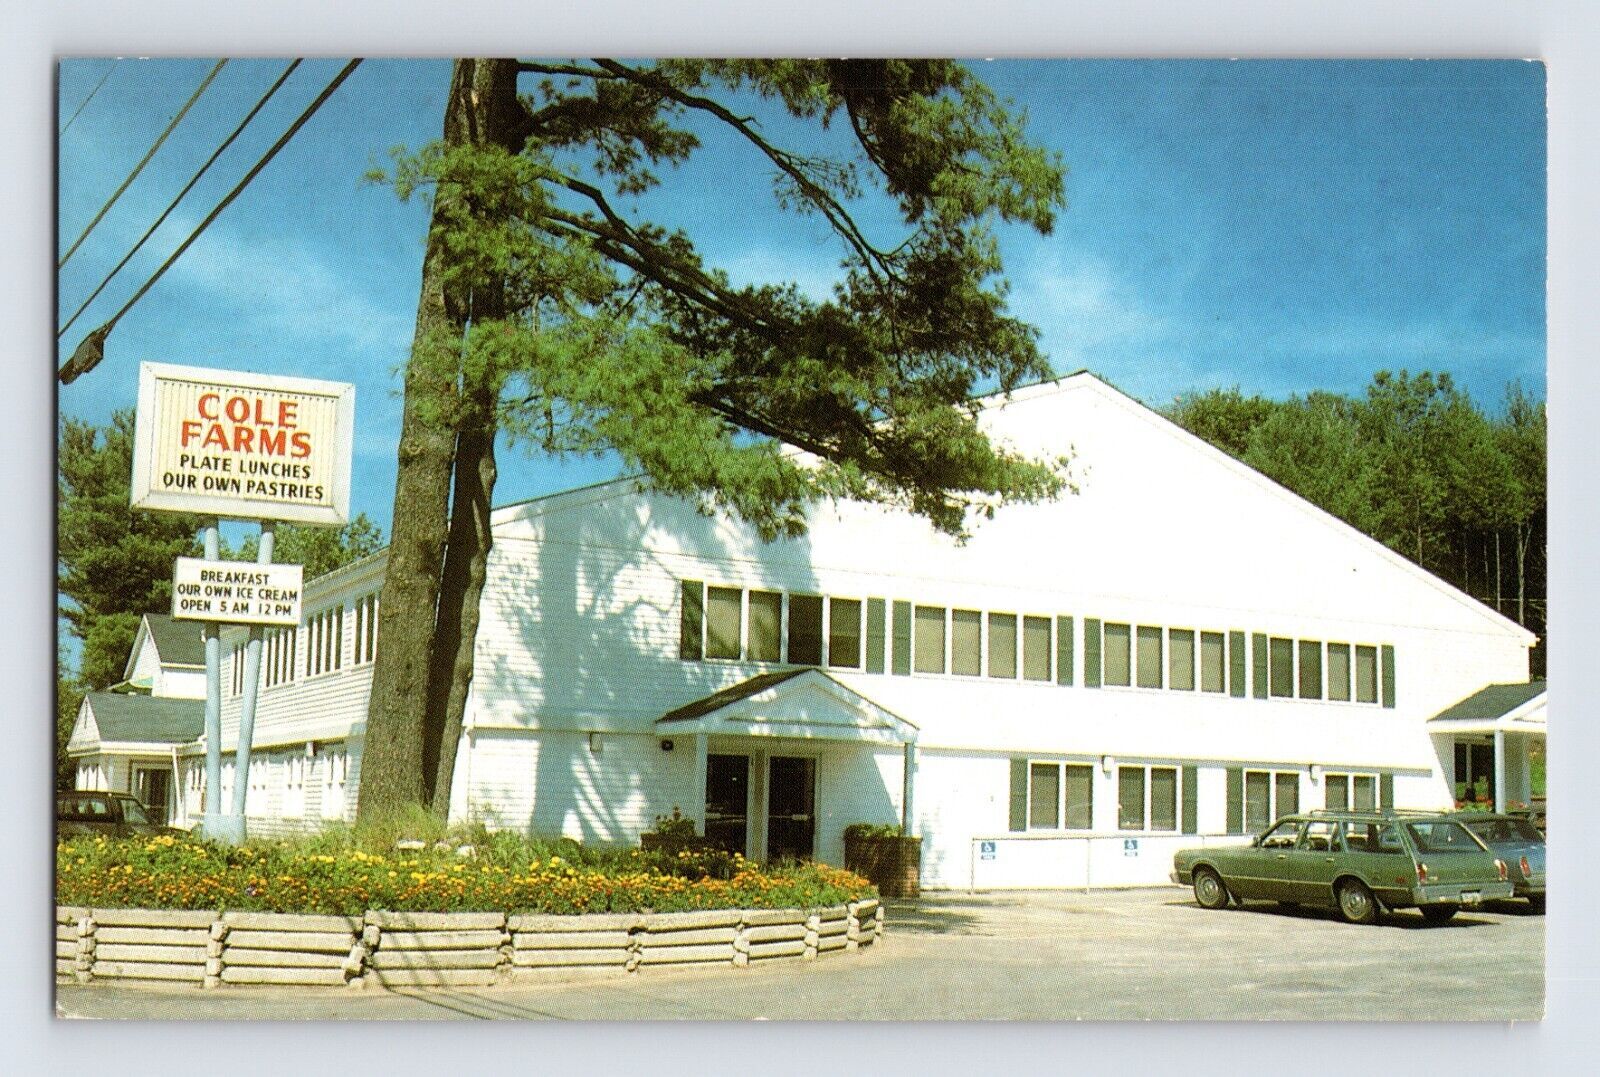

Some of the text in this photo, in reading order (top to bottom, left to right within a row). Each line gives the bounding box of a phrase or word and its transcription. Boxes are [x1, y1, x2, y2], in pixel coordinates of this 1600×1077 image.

[198, 393, 298, 429] COLE
[181, 421, 312, 459] FARMS
[180, 454, 311, 479] PLATE LUNCHES
[163, 472, 324, 500] OUR OWN PASTRIES
[201, 570, 270, 585] BREAKFAST
[178, 584, 298, 601] OUR OWN ICE CREAM
[181, 600, 292, 616] OPEN 5 AM 12 PM
